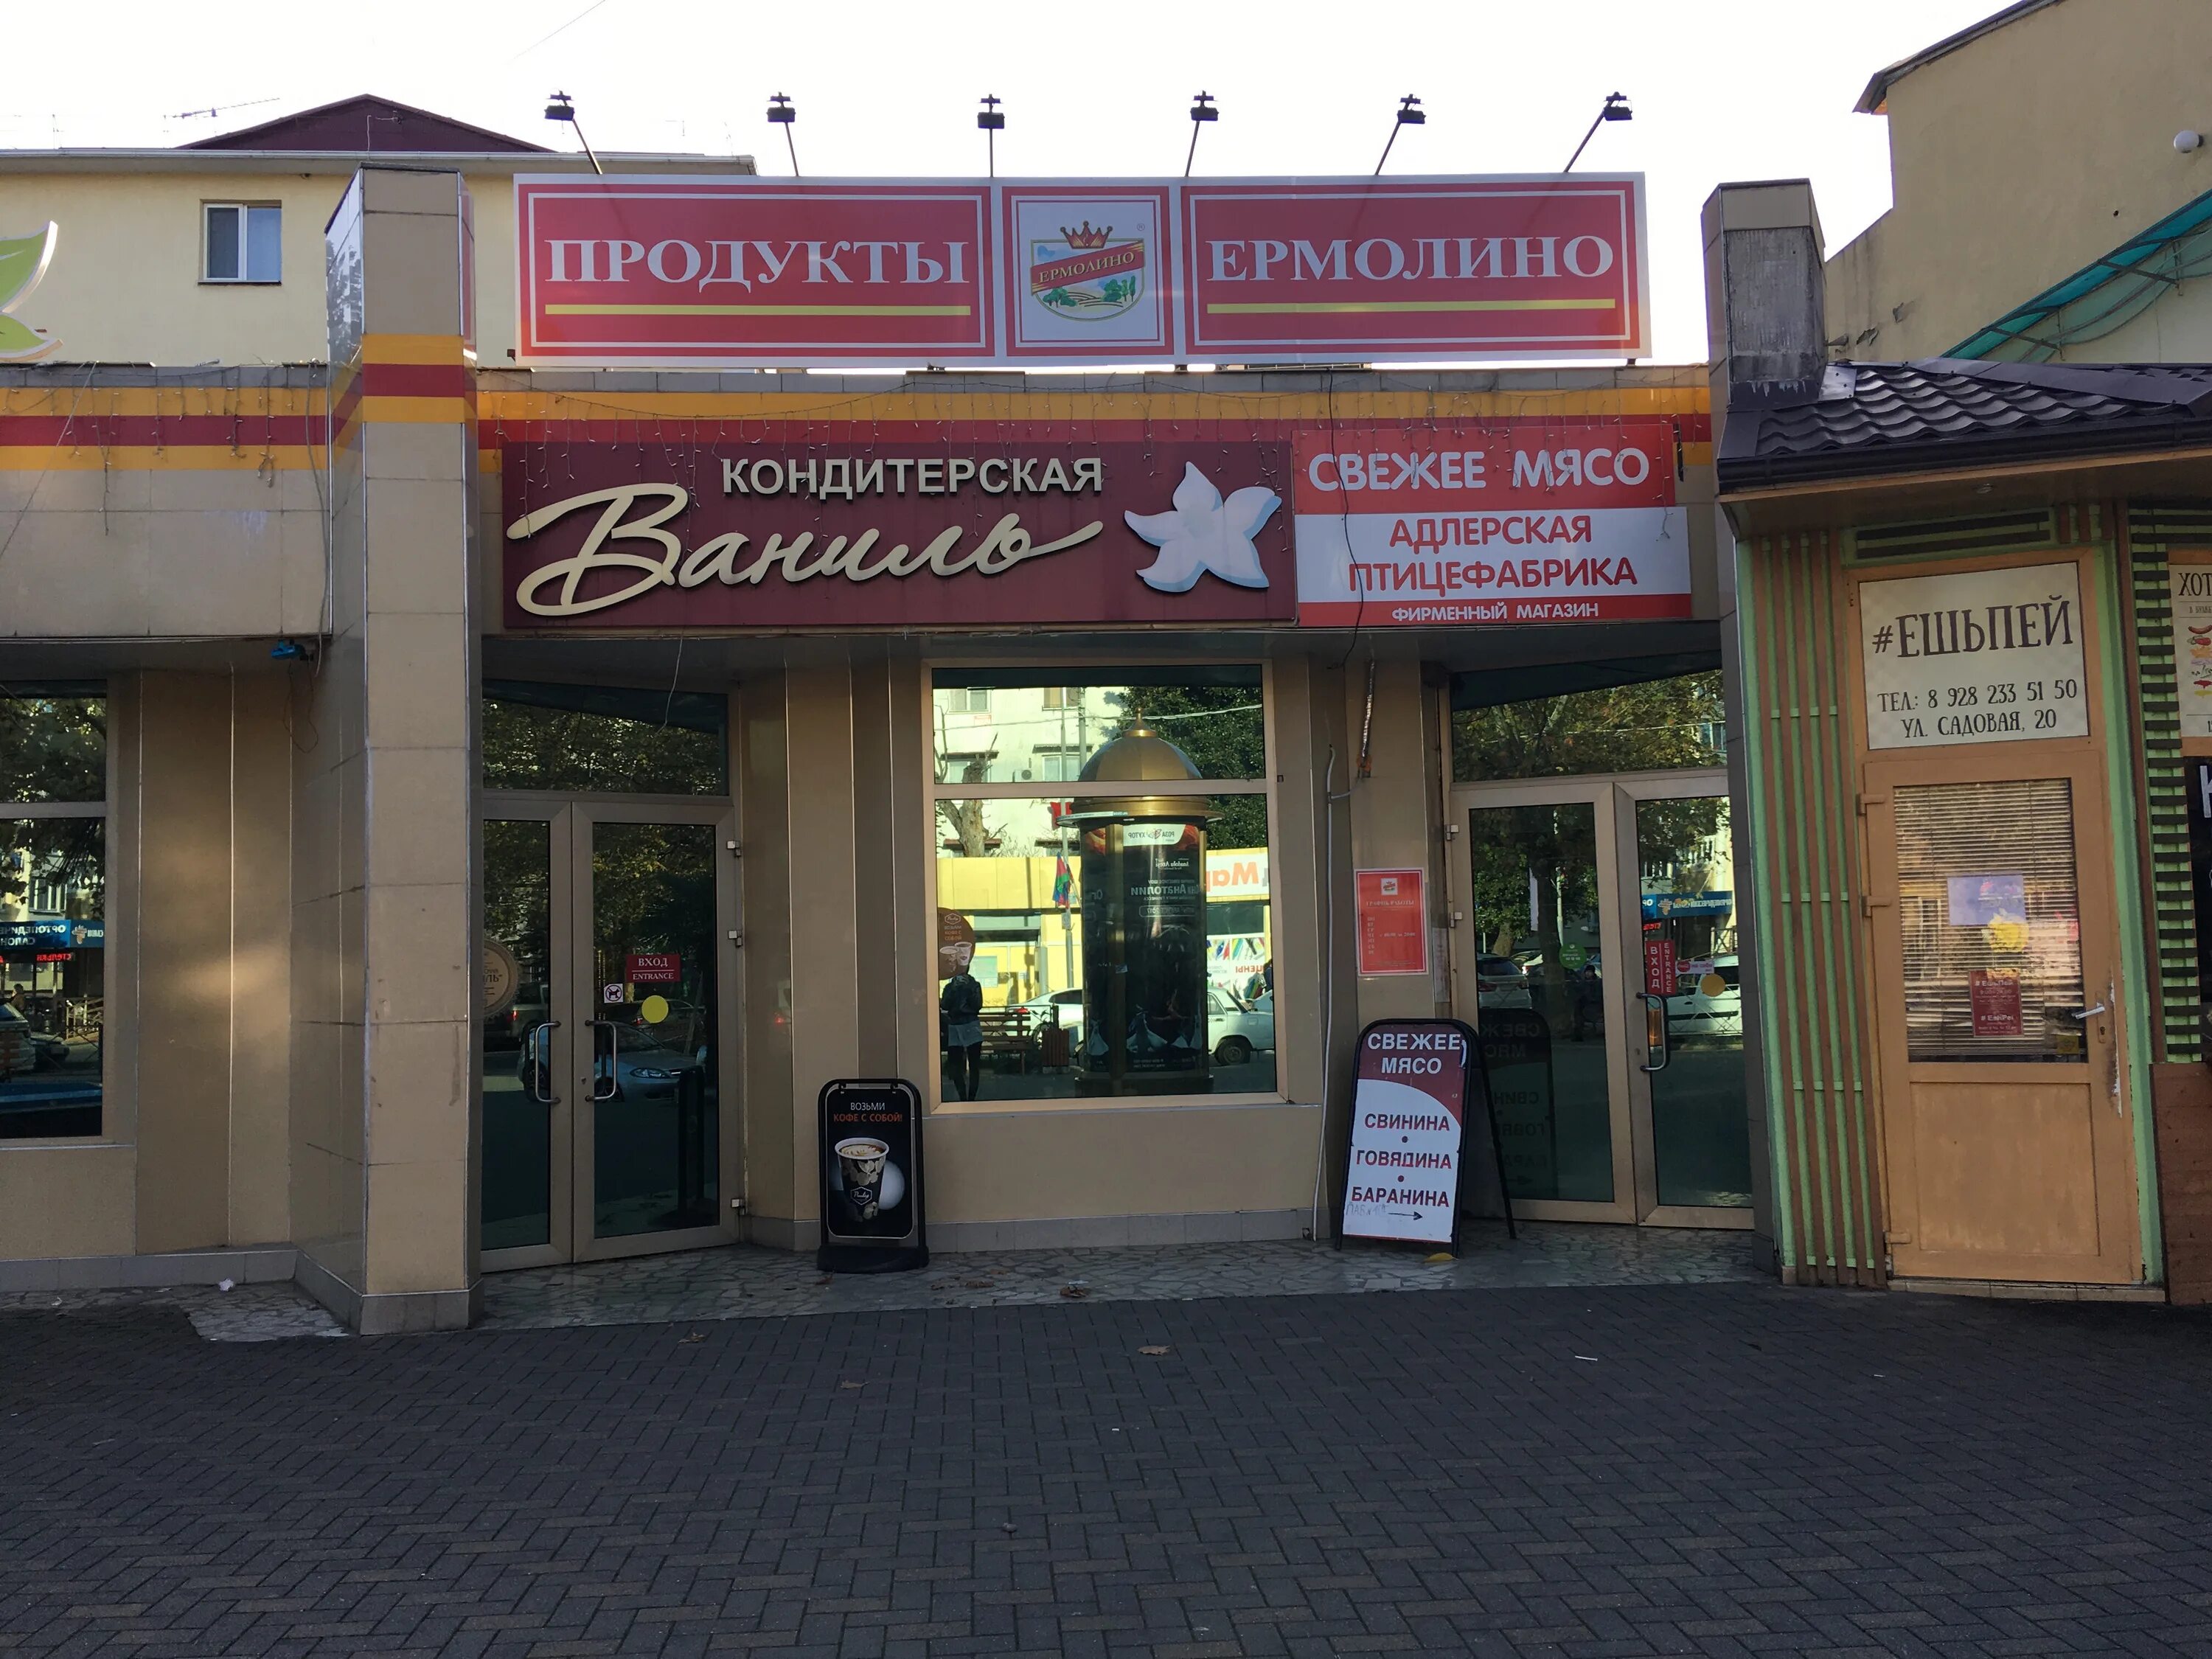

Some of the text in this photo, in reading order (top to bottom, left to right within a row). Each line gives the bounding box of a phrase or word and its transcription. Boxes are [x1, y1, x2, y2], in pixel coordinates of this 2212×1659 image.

[544, 239, 970, 293] ПРОДУКТЫ
[1039, 251, 1135, 283] ЕРМОЛИНО
[1207, 235, 1613, 282] ЕРМОЛИНО
[723, 457, 1102, 501] КОНДИТЕРСКАЯ
[1309, 448, 1649, 491] СВЕЖЕЕ МЯСО
[507, 482, 1104, 616] Ваниль
[1390, 515, 1592, 554] АДЛЕРСКАЯ
[1349, 557, 1638, 597] ПТИЦЕФАБРИКА
[1391, 602, 1599, 622] ФИРМЕННЫЙ МАГАЗИН
[1872, 594, 2073, 657] #ЕШЬПЕЙ
[1928, 689, 1938, 708] 8
[1947, 686, 1978, 707] 928
[1987, 684, 2017, 704] 233
[2027, 681, 2043, 702] 51
[2054, 679, 2077, 699] 50
[1901, 709, 2056, 738] УЛ. САДОВАЯ, 20
[639, 958, 668, 967] ВХОД
[1650, 946, 1660, 989] ВХОД
[1664, 942, 1672, 993] ENTRANCE
[1368, 1033, 1461, 1051] СВЕЖЕЕ
[1381, 1057, 1442, 1074] МЯСО
[833, 1113, 859, 1121] КОФЕ
[861, 1113, 866, 1121] С
[850, 1102, 886, 1110] ВОЗЬМИ
[1365, 1113, 1450, 1130] СВИНИНА
[1356, 1150, 1452, 1169] ГОВЯДИНА
[1352, 1186, 1450, 1207] БАРАНИНА
